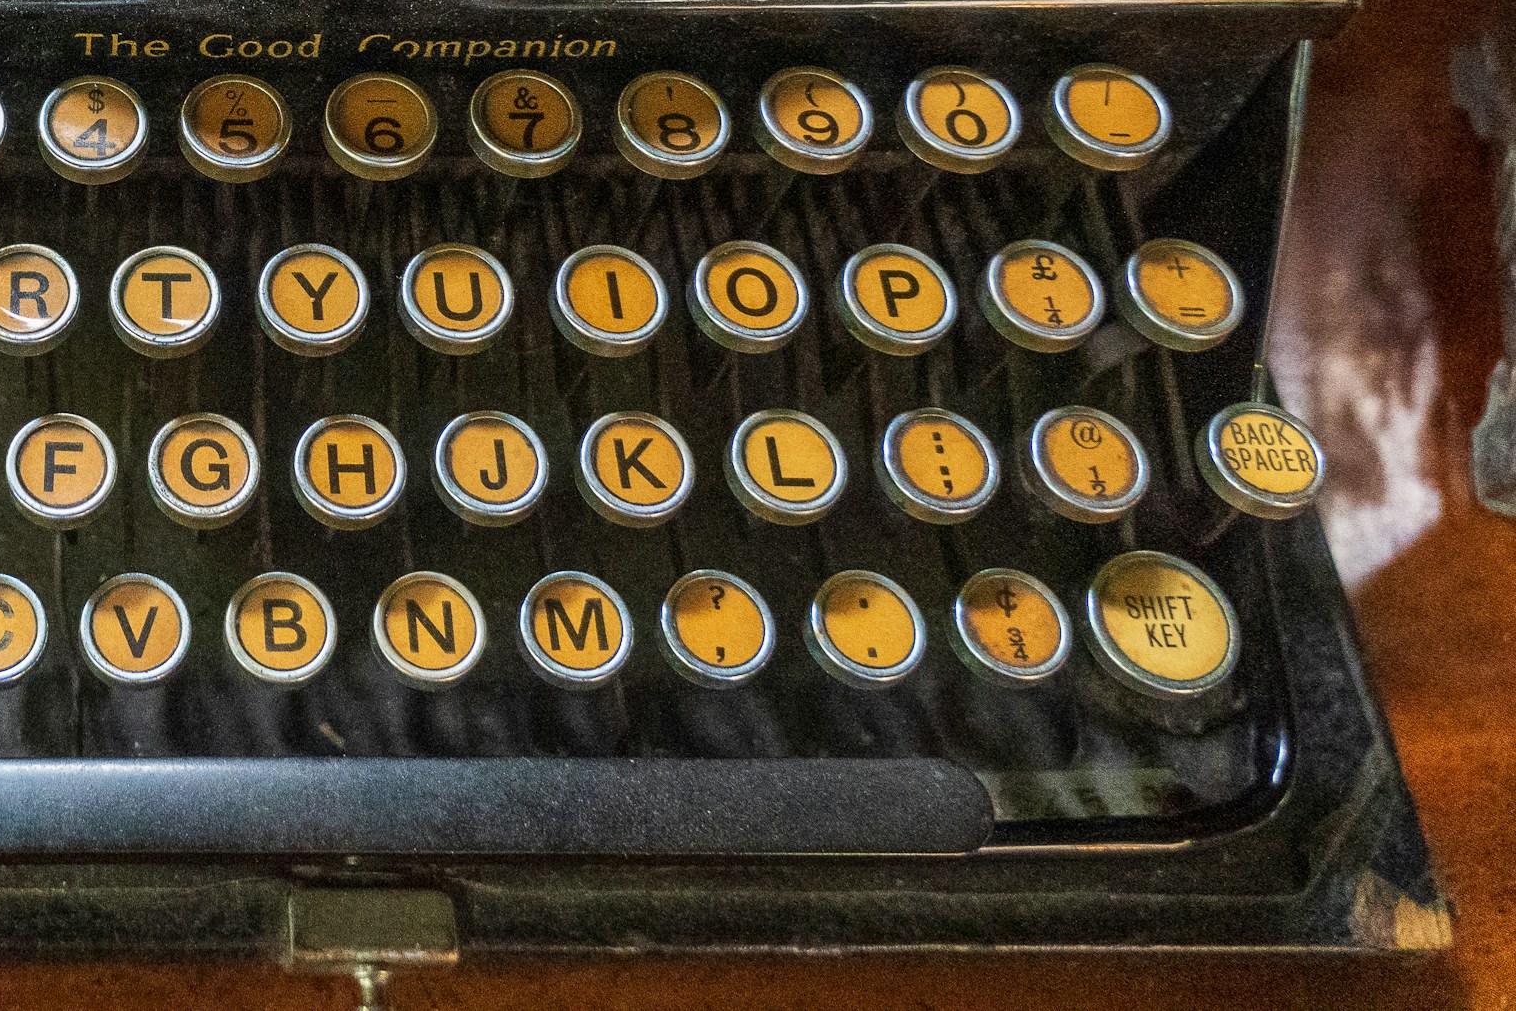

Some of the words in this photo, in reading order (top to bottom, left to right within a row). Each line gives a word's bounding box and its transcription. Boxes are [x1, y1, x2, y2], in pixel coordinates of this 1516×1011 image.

[74, 32, 171, 58] The
[199, 32, 323, 59] Good
[73, 118, 116, 158] 4
[218, 118, 258, 156] 5
[363, 116, 405, 155] 6
[507, 111, 546, 151] 7
[656, 112, 701, 152] 8
[797, 108, 841, 146] 9
[8, 269, 53, 320] R
[140, 272, 193, 320] T
[290, 270, 340, 322] Y
[433, 270, 482, 322] U
[605, 269, 625, 320] I
[725, 266, 779, 318] O
[877, 268, 922, 319] P
[1228, 421, 1293, 446] BACK
[42, 440, 85, 493] F
[179, 437, 232, 491] G
[326, 442, 377, 495] H
[479, 438, 509, 491] J
[612, 436, 668, 490] K
[765, 434, 816, 489] L
[1224, 447, 1317, 473] SPACER
[112, 604, 159, 660] V
[261, 597, 308, 654] B
[405, 598, 457, 656] N
[543, 596, 610, 653] M
[1124, 594, 1193, 622] SHIFT
[1145, 623, 1188, 650] KEY
